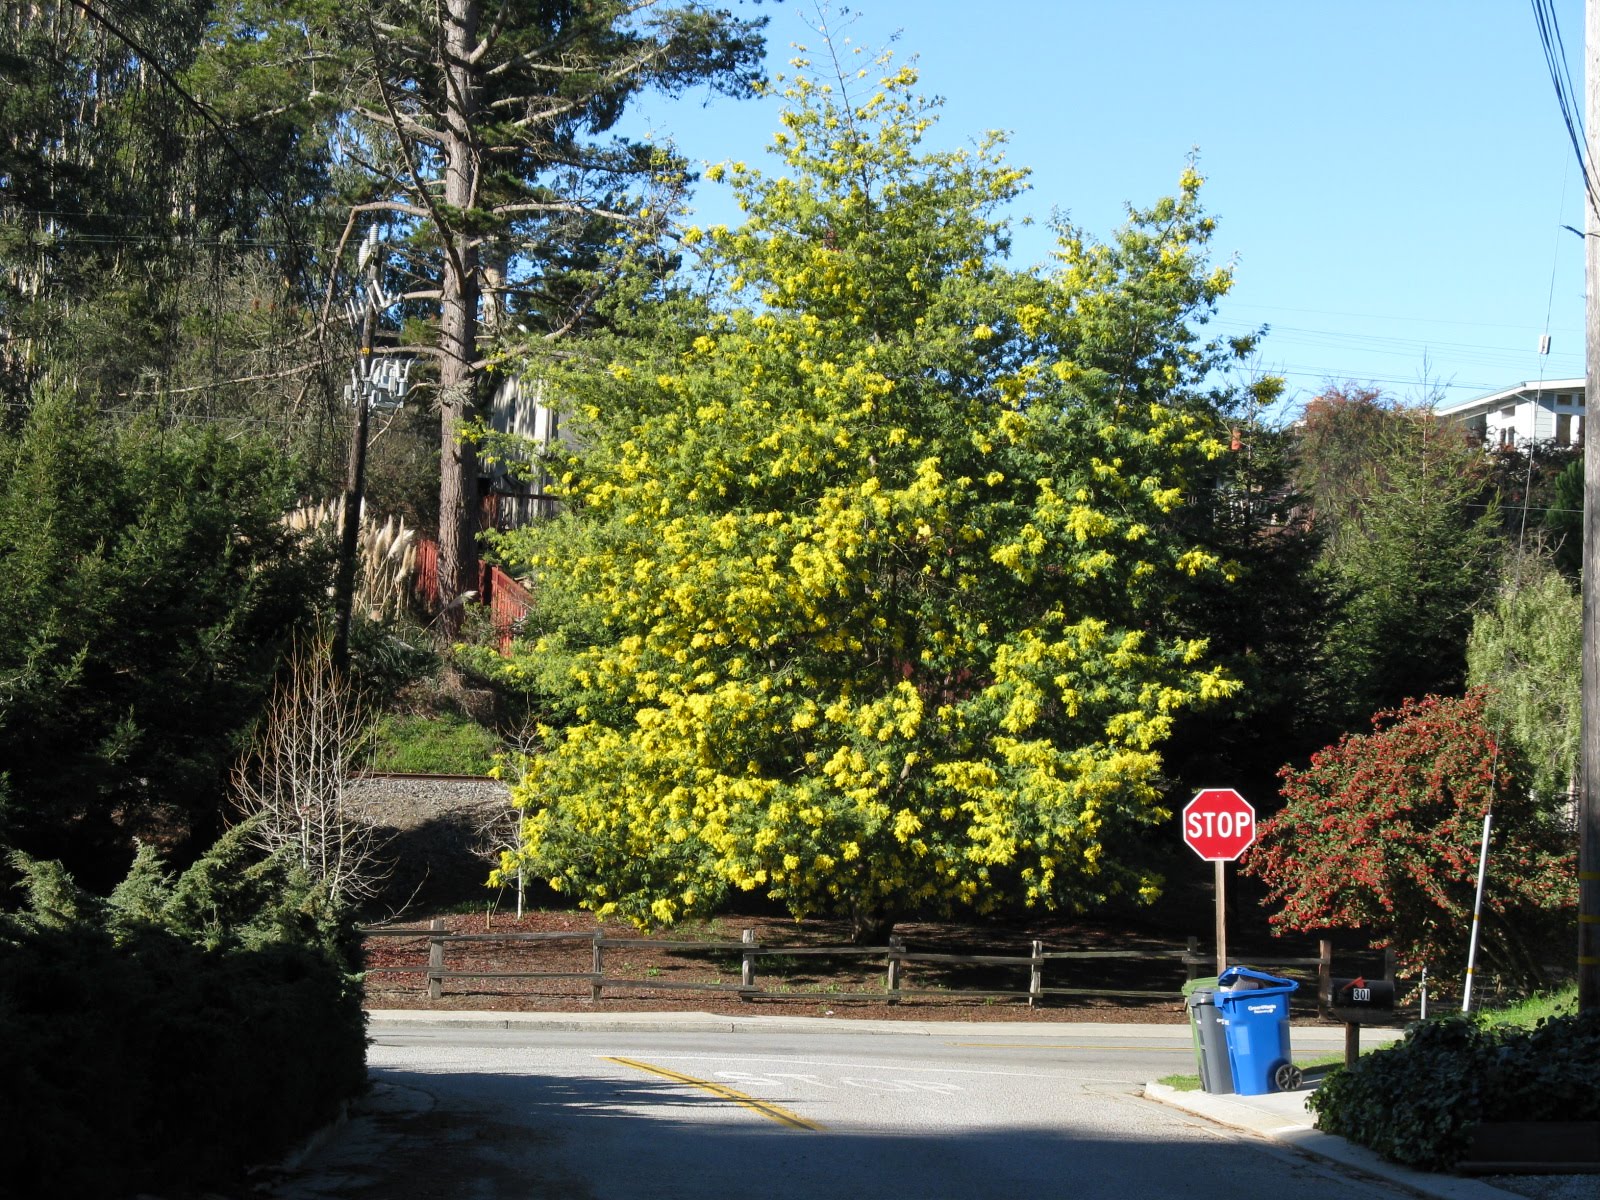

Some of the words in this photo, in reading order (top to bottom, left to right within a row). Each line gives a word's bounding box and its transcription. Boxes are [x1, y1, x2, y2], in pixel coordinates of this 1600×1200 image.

[1188, 812, 1250, 838] STOP
[1354, 988, 1368, 1000] 301
[713, 1071, 964, 1095] STOP
